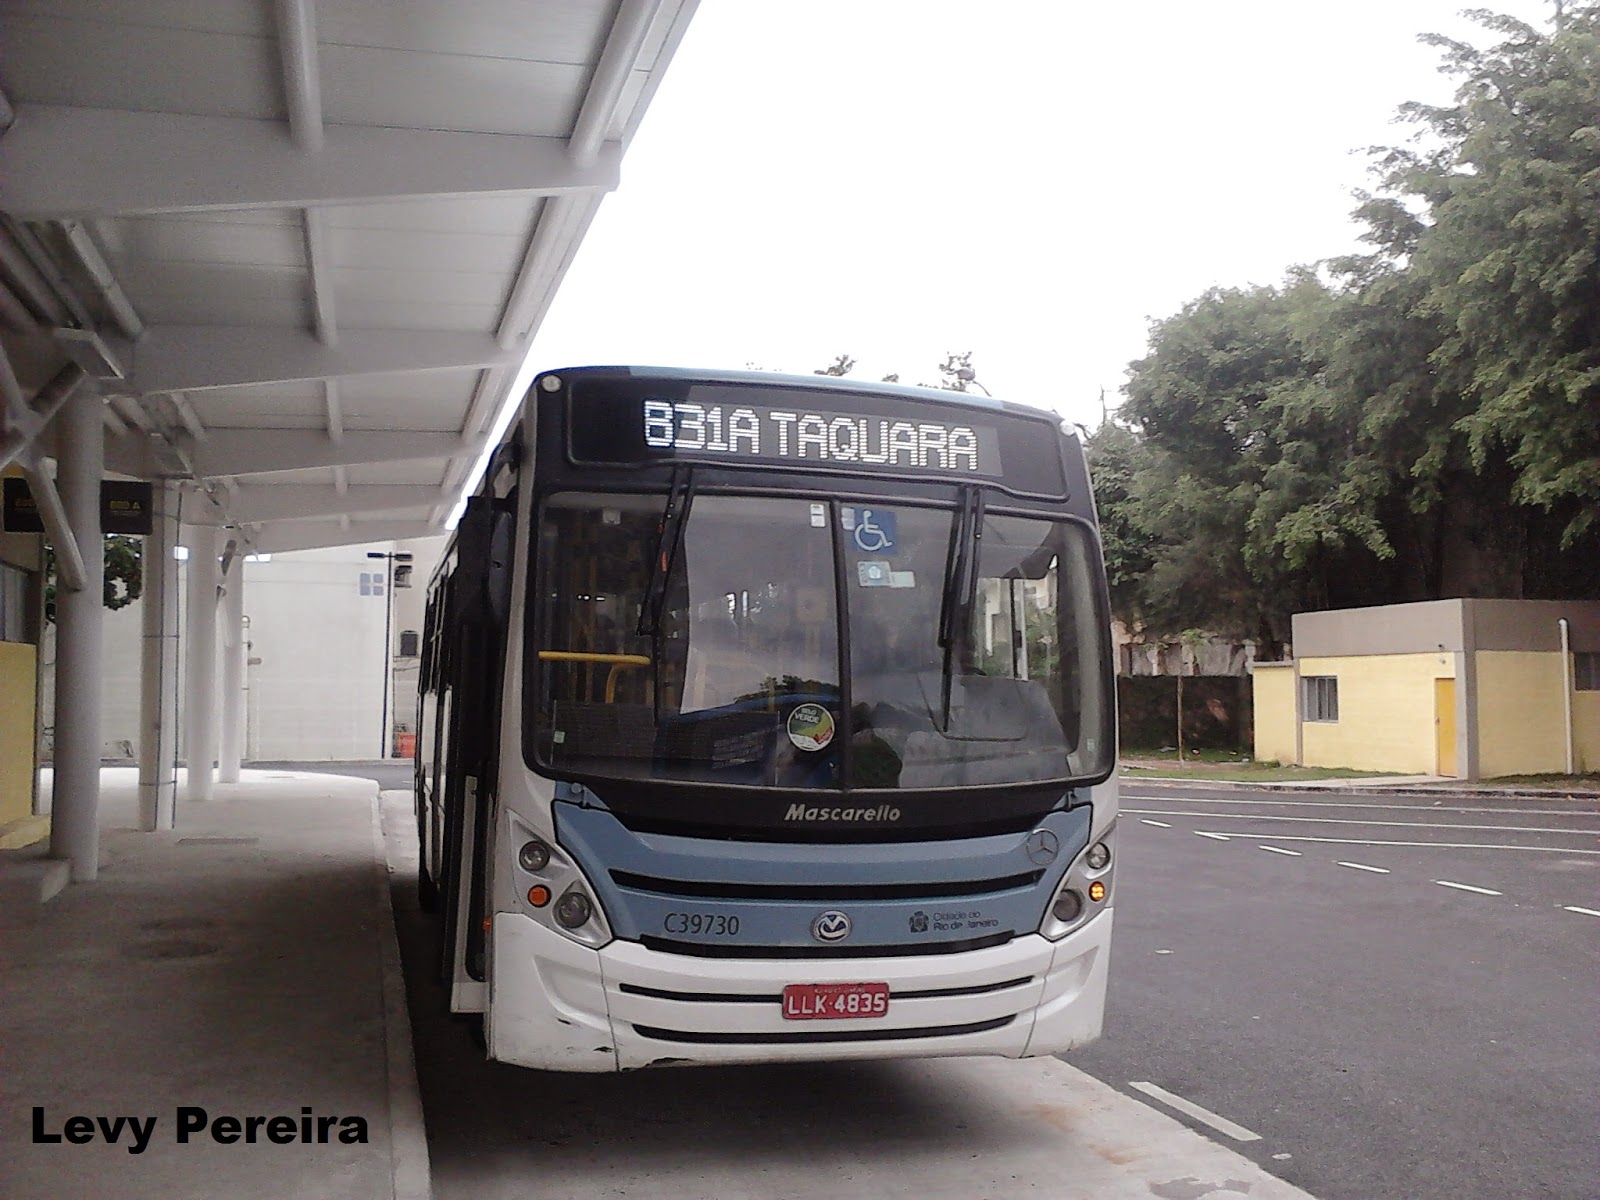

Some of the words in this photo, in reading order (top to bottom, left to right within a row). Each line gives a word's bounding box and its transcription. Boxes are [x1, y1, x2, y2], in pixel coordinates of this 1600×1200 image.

[769, 411, 977, 471] TAQUARA
[784, 803, 901, 821] Mascarello
[664, 912, 740, 936] C39730
[933, 922, 949, 931] Rio
